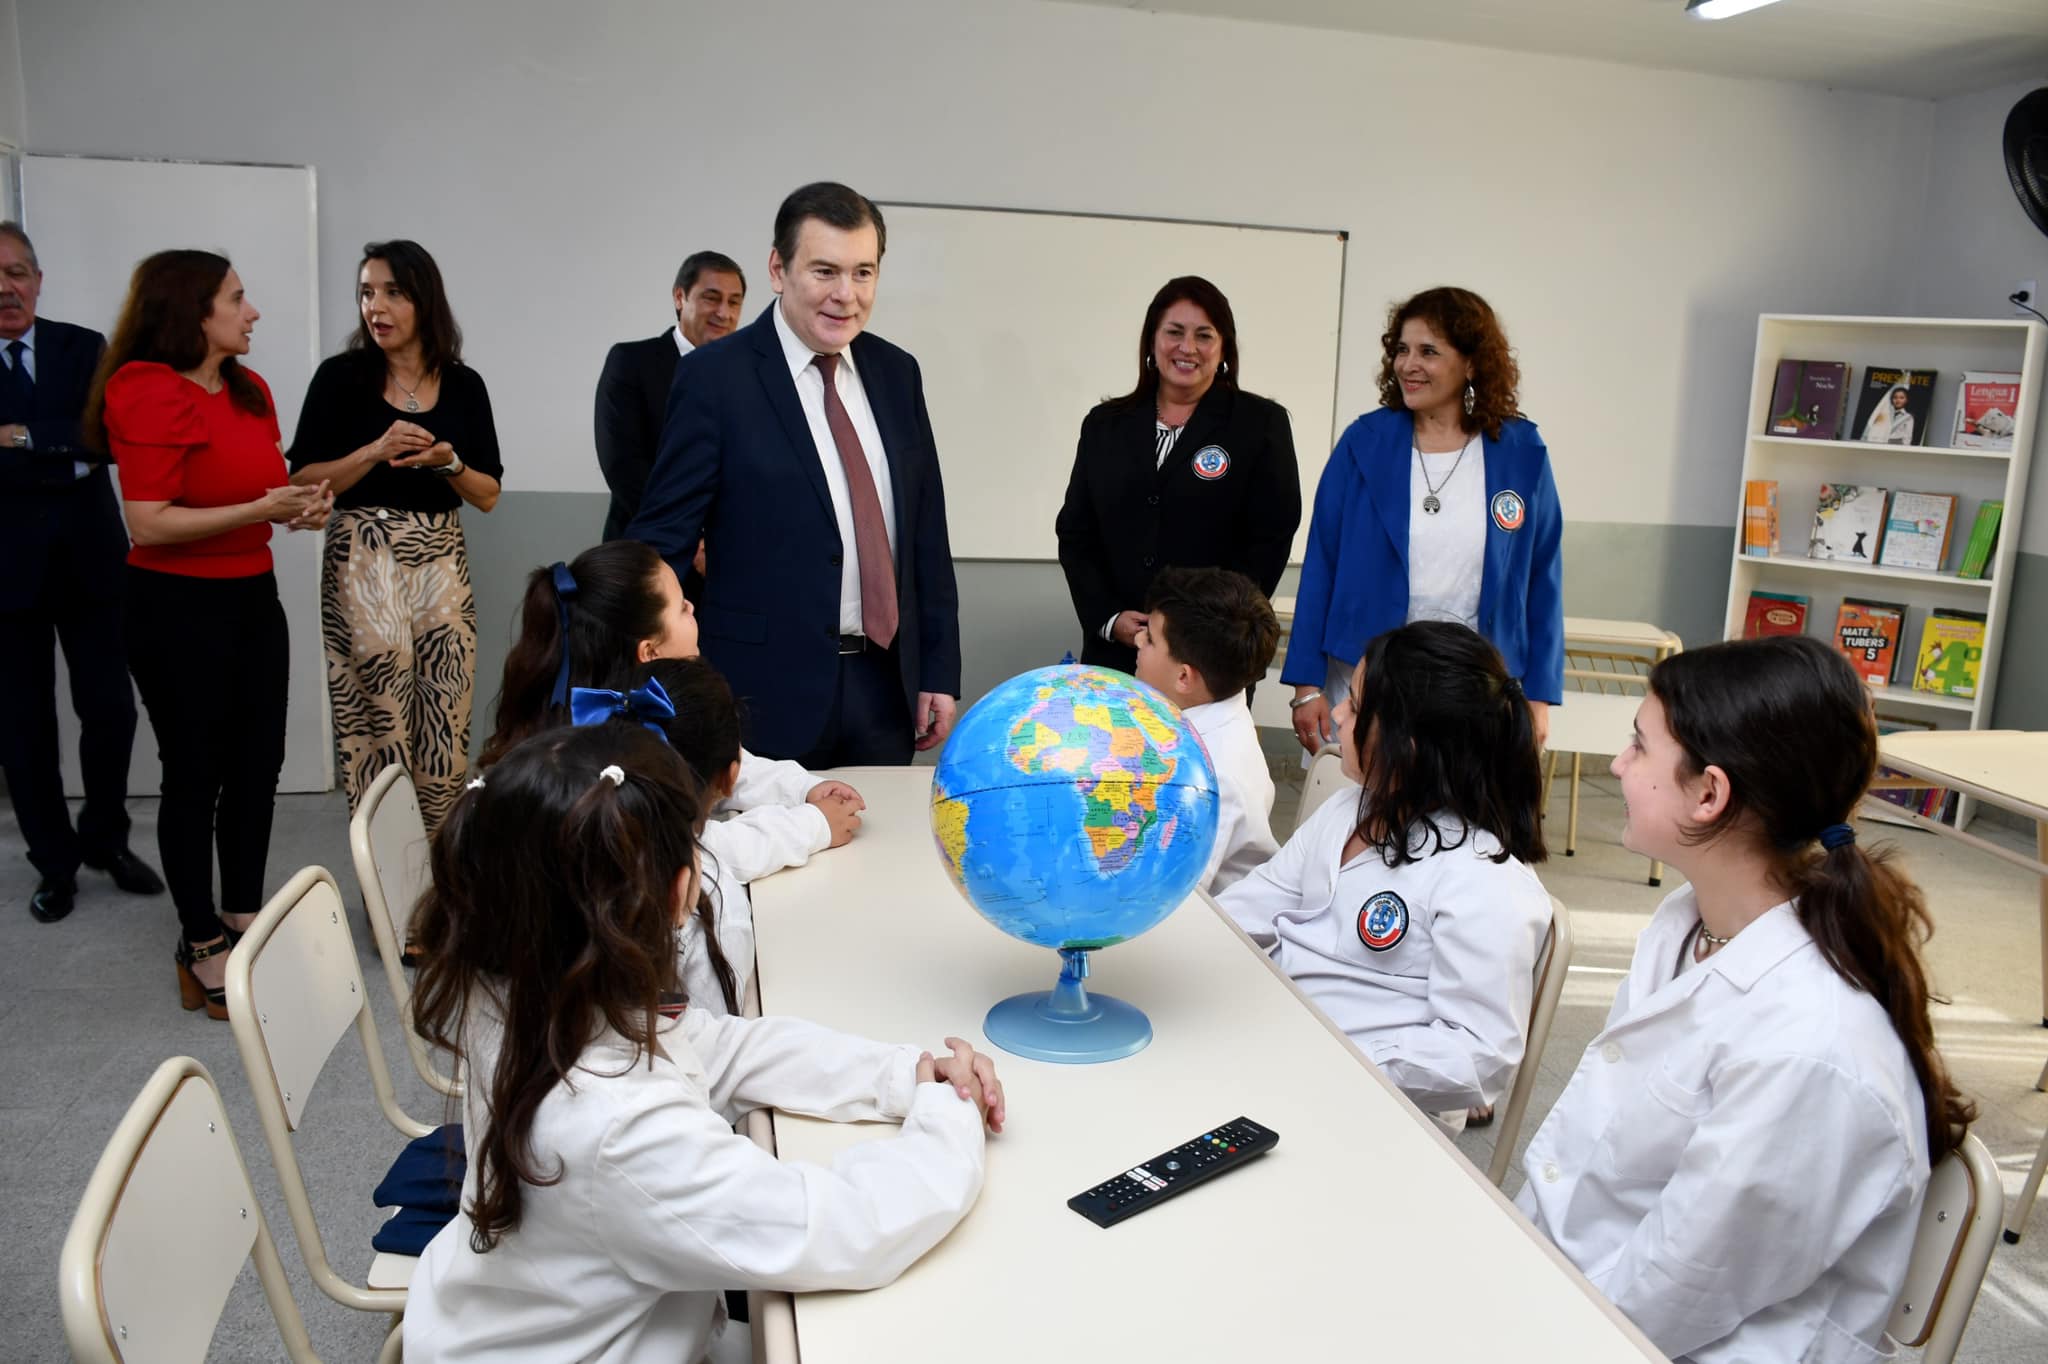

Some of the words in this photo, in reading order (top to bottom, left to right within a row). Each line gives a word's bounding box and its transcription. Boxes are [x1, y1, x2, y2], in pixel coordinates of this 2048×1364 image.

[1970, 385, 2008, 400] Lengua
[1841, 627, 1870, 637] MATE
[1845, 637, 1885, 648] TUBERS
[1866, 647, 1876, 660] 5
